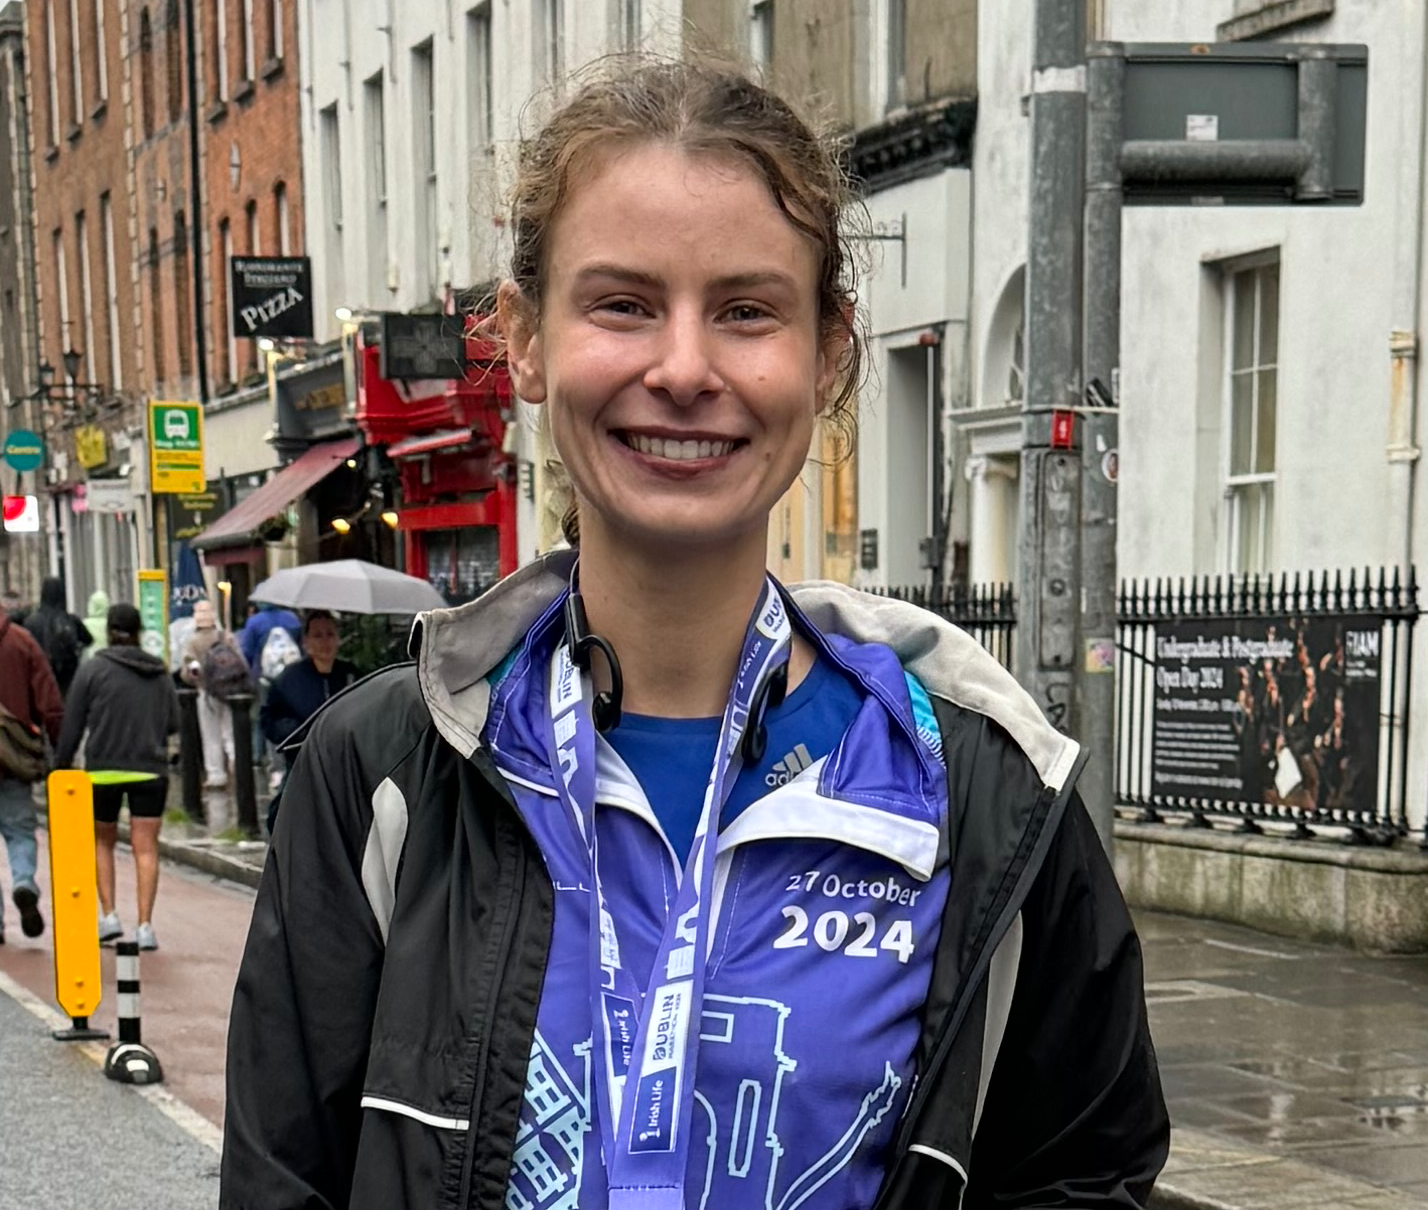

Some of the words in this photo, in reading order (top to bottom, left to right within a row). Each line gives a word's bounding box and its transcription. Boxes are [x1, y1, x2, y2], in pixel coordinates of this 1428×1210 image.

[240, 286, 304, 332] PIZZA
[785, 870, 821, 892] 27
[822, 874, 922, 907] October
[773, 905, 915, 964] 2024
[652, 1079, 664, 1103] Life
[648, 1102, 661, 1127] Irish
